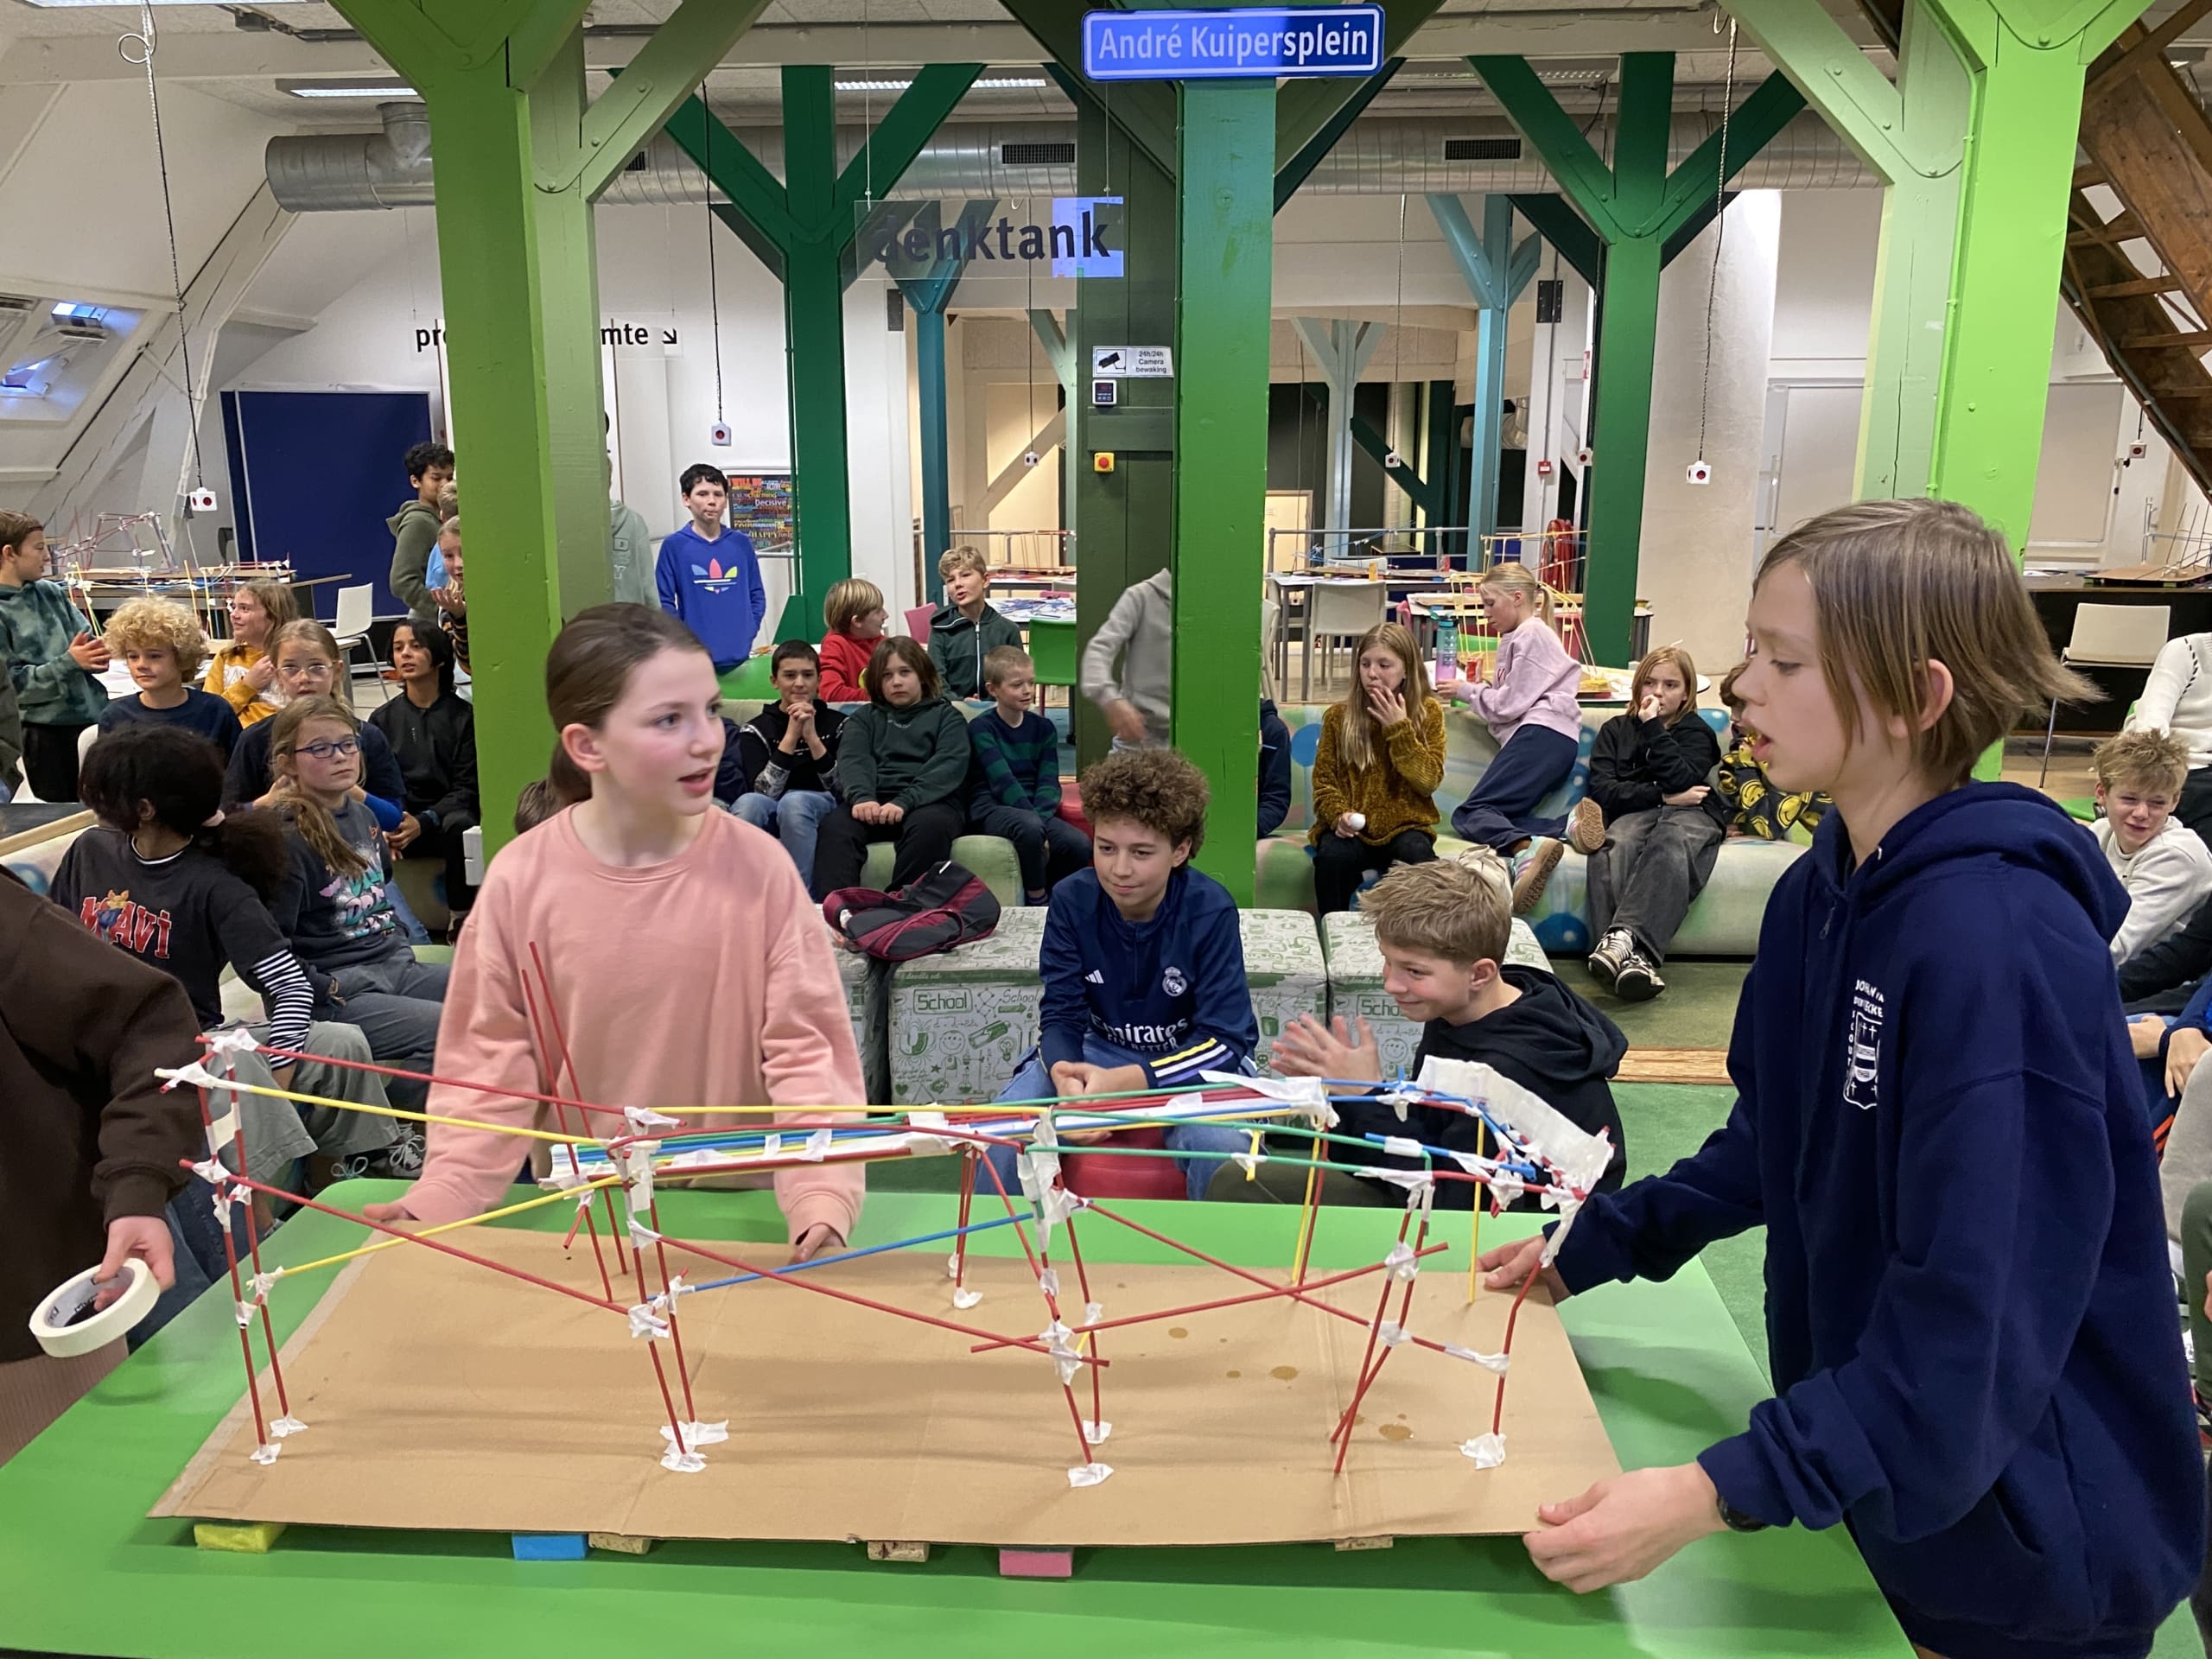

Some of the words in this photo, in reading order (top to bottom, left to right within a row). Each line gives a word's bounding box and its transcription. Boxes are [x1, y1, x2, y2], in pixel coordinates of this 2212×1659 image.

[1098, 23, 1183, 60] André
[1191, 22, 1368, 67] Kuipersplein
[871, 211, 1111, 263] denktank
[917, 992, 968, 1011] School
[1090, 1013, 1189, 1044] Emirates
